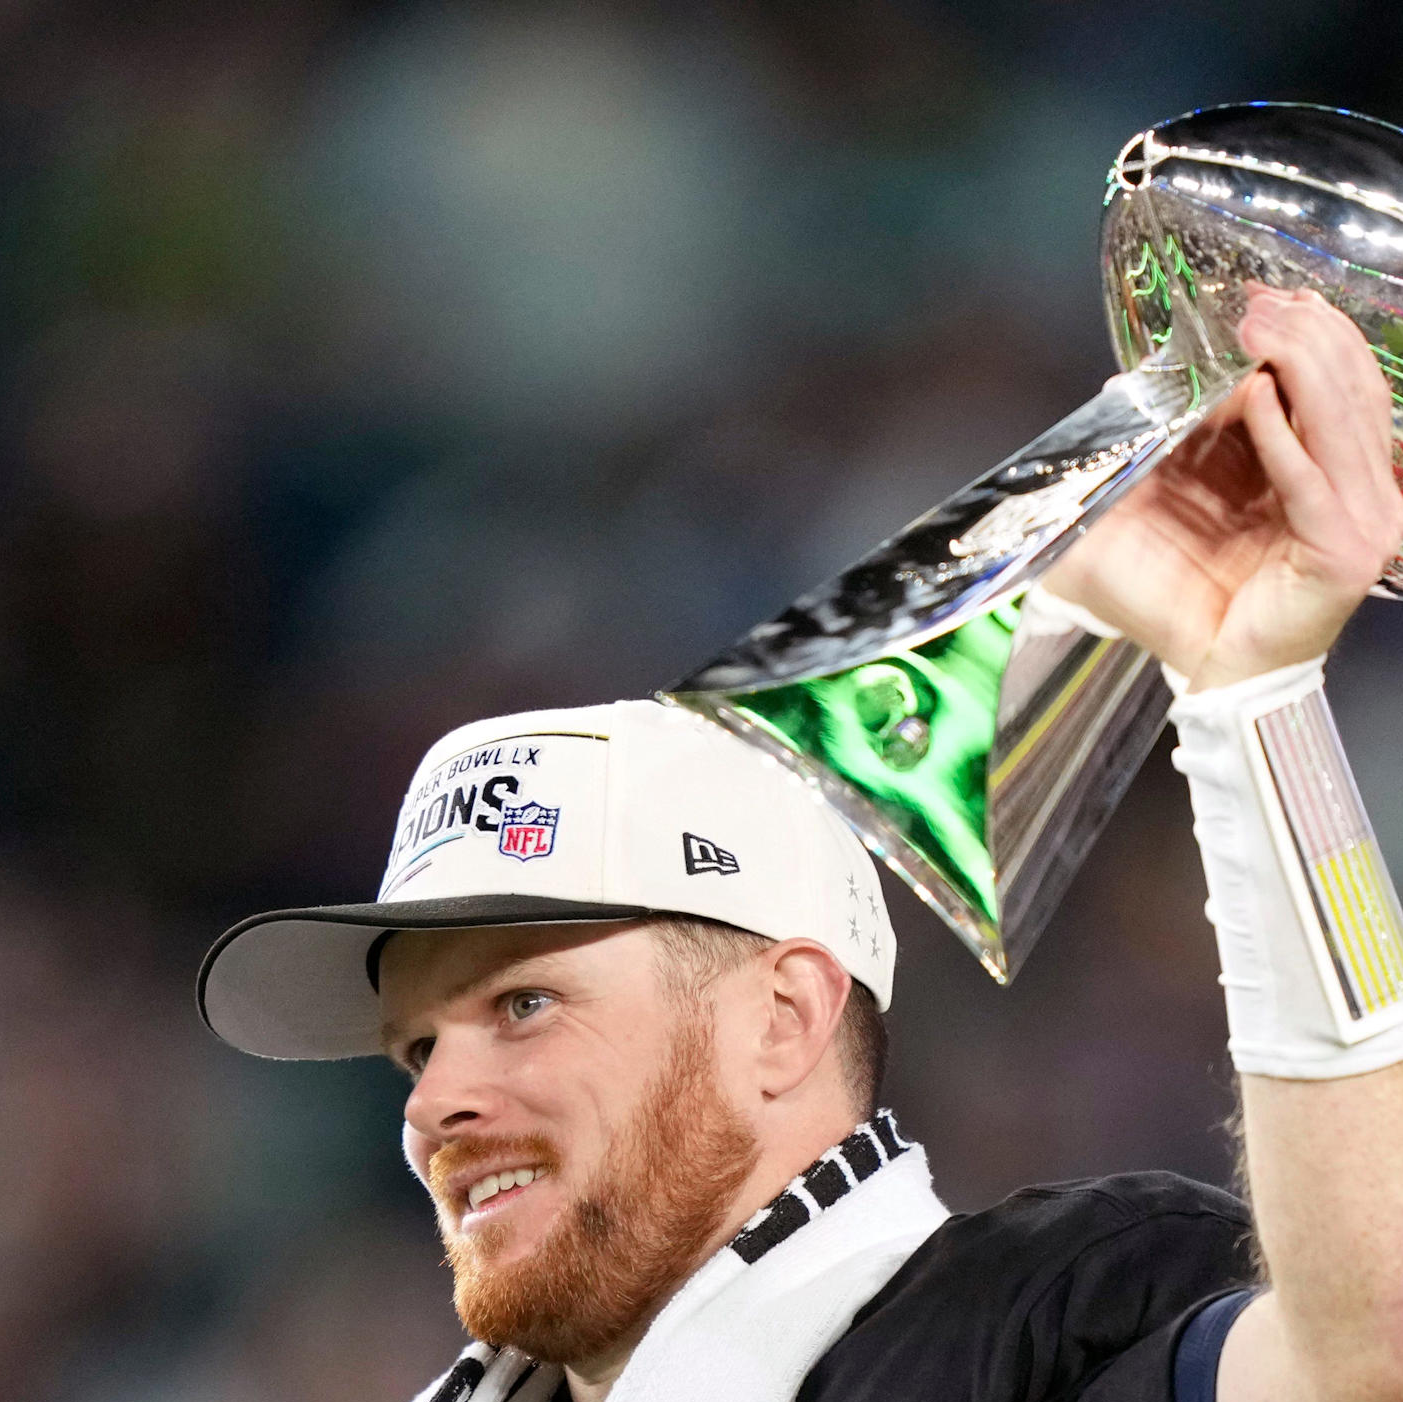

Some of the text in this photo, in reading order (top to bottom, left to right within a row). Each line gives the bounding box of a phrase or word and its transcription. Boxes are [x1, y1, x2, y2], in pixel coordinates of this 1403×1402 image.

[448, 748, 503, 780] BOWL
[512, 748, 540, 766] LX
[392, 776, 519, 864] PIONS
[503, 827, 547, 854] NFL
